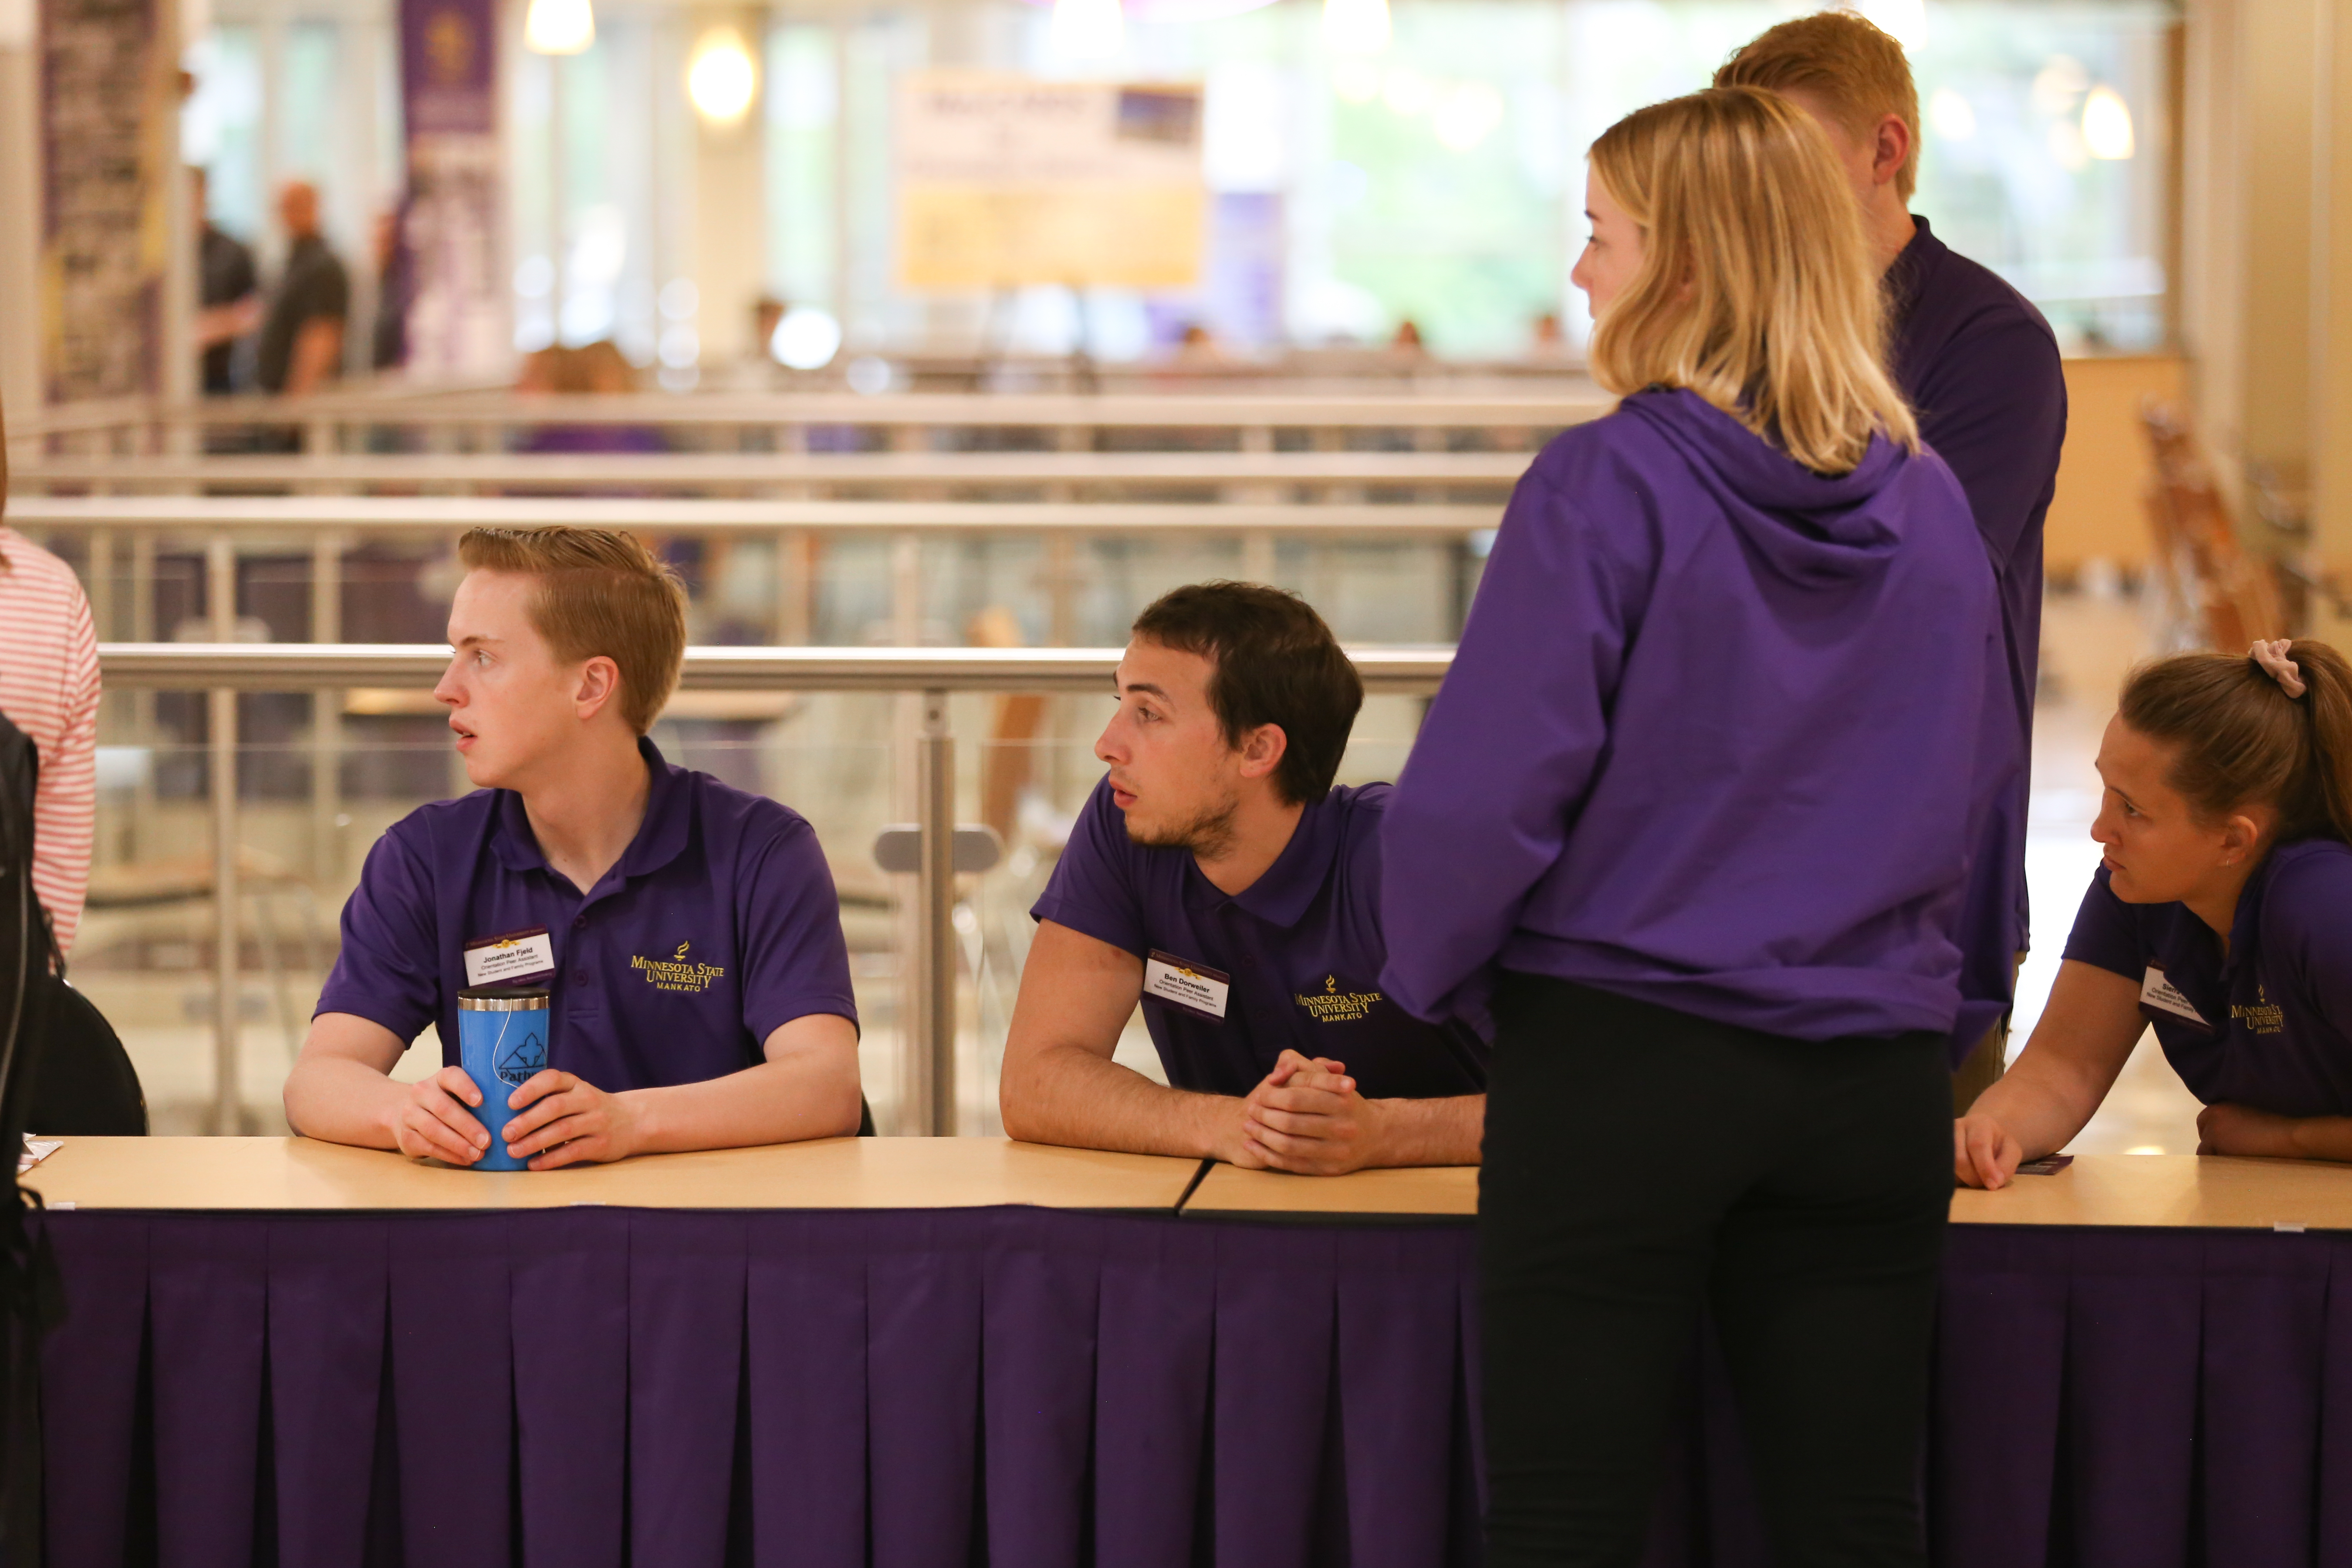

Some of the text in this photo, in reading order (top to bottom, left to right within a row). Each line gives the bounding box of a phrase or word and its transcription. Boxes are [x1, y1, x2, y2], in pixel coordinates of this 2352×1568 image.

[483, 947, 533, 963] Jonathan Fjeld
[631, 955, 724, 977] MINNESOTA STATE
[646, 970, 712, 988] UNIVERSITY
[657, 982, 701, 992] MANKATO
[1164, 973, 1210, 993] Ben Dorweiler
[1159, 979, 1182, 990] Orientation
[1194, 991, 1213, 1001] Assistant
[1294, 992, 1382, 1006] MINNESOTA STATE
[1309, 1002, 1369, 1017] UNIVERSITY
[1322, 1012, 1362, 1023] MANKATO
